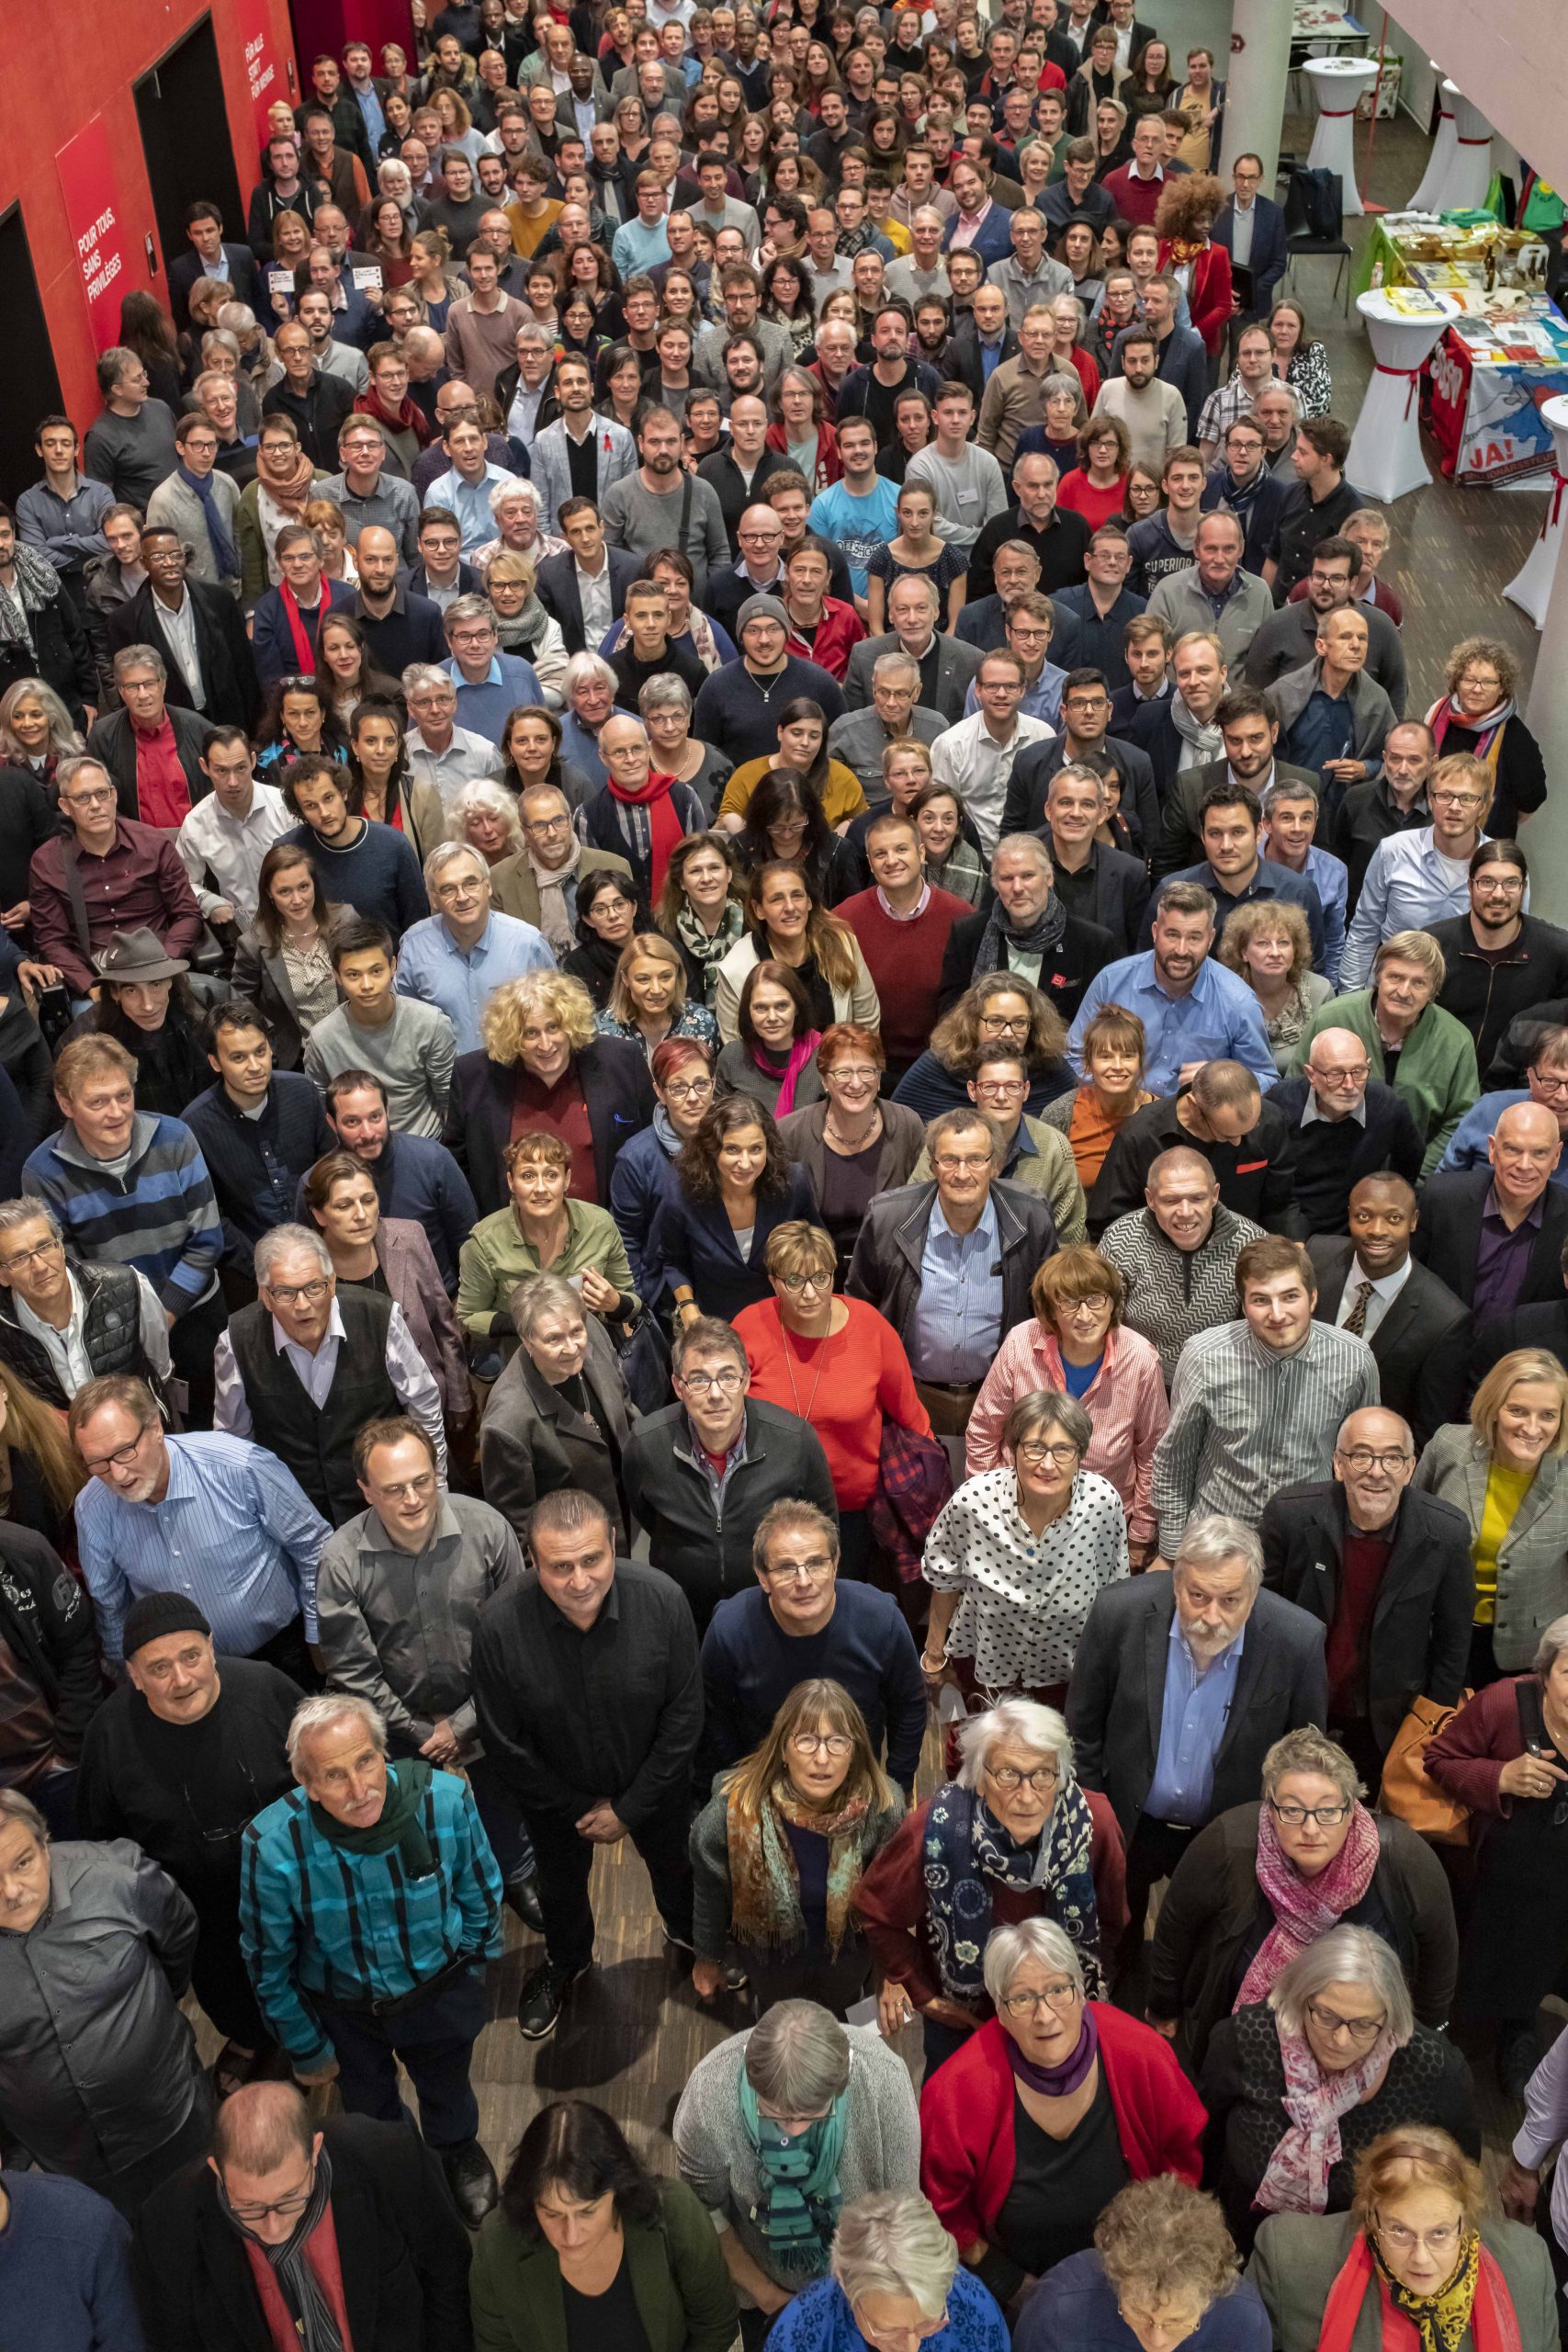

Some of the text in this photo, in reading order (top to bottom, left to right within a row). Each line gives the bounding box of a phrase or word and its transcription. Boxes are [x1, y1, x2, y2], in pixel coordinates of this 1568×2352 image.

[78, 225, 98, 258] POUR
[83, 248, 102, 280] SANS
[87, 252, 122, 304] PRIVILÈGES
[1470, 438, 1515, 469] JA!
[1145, 557, 1192, 573] SUPERIOR
